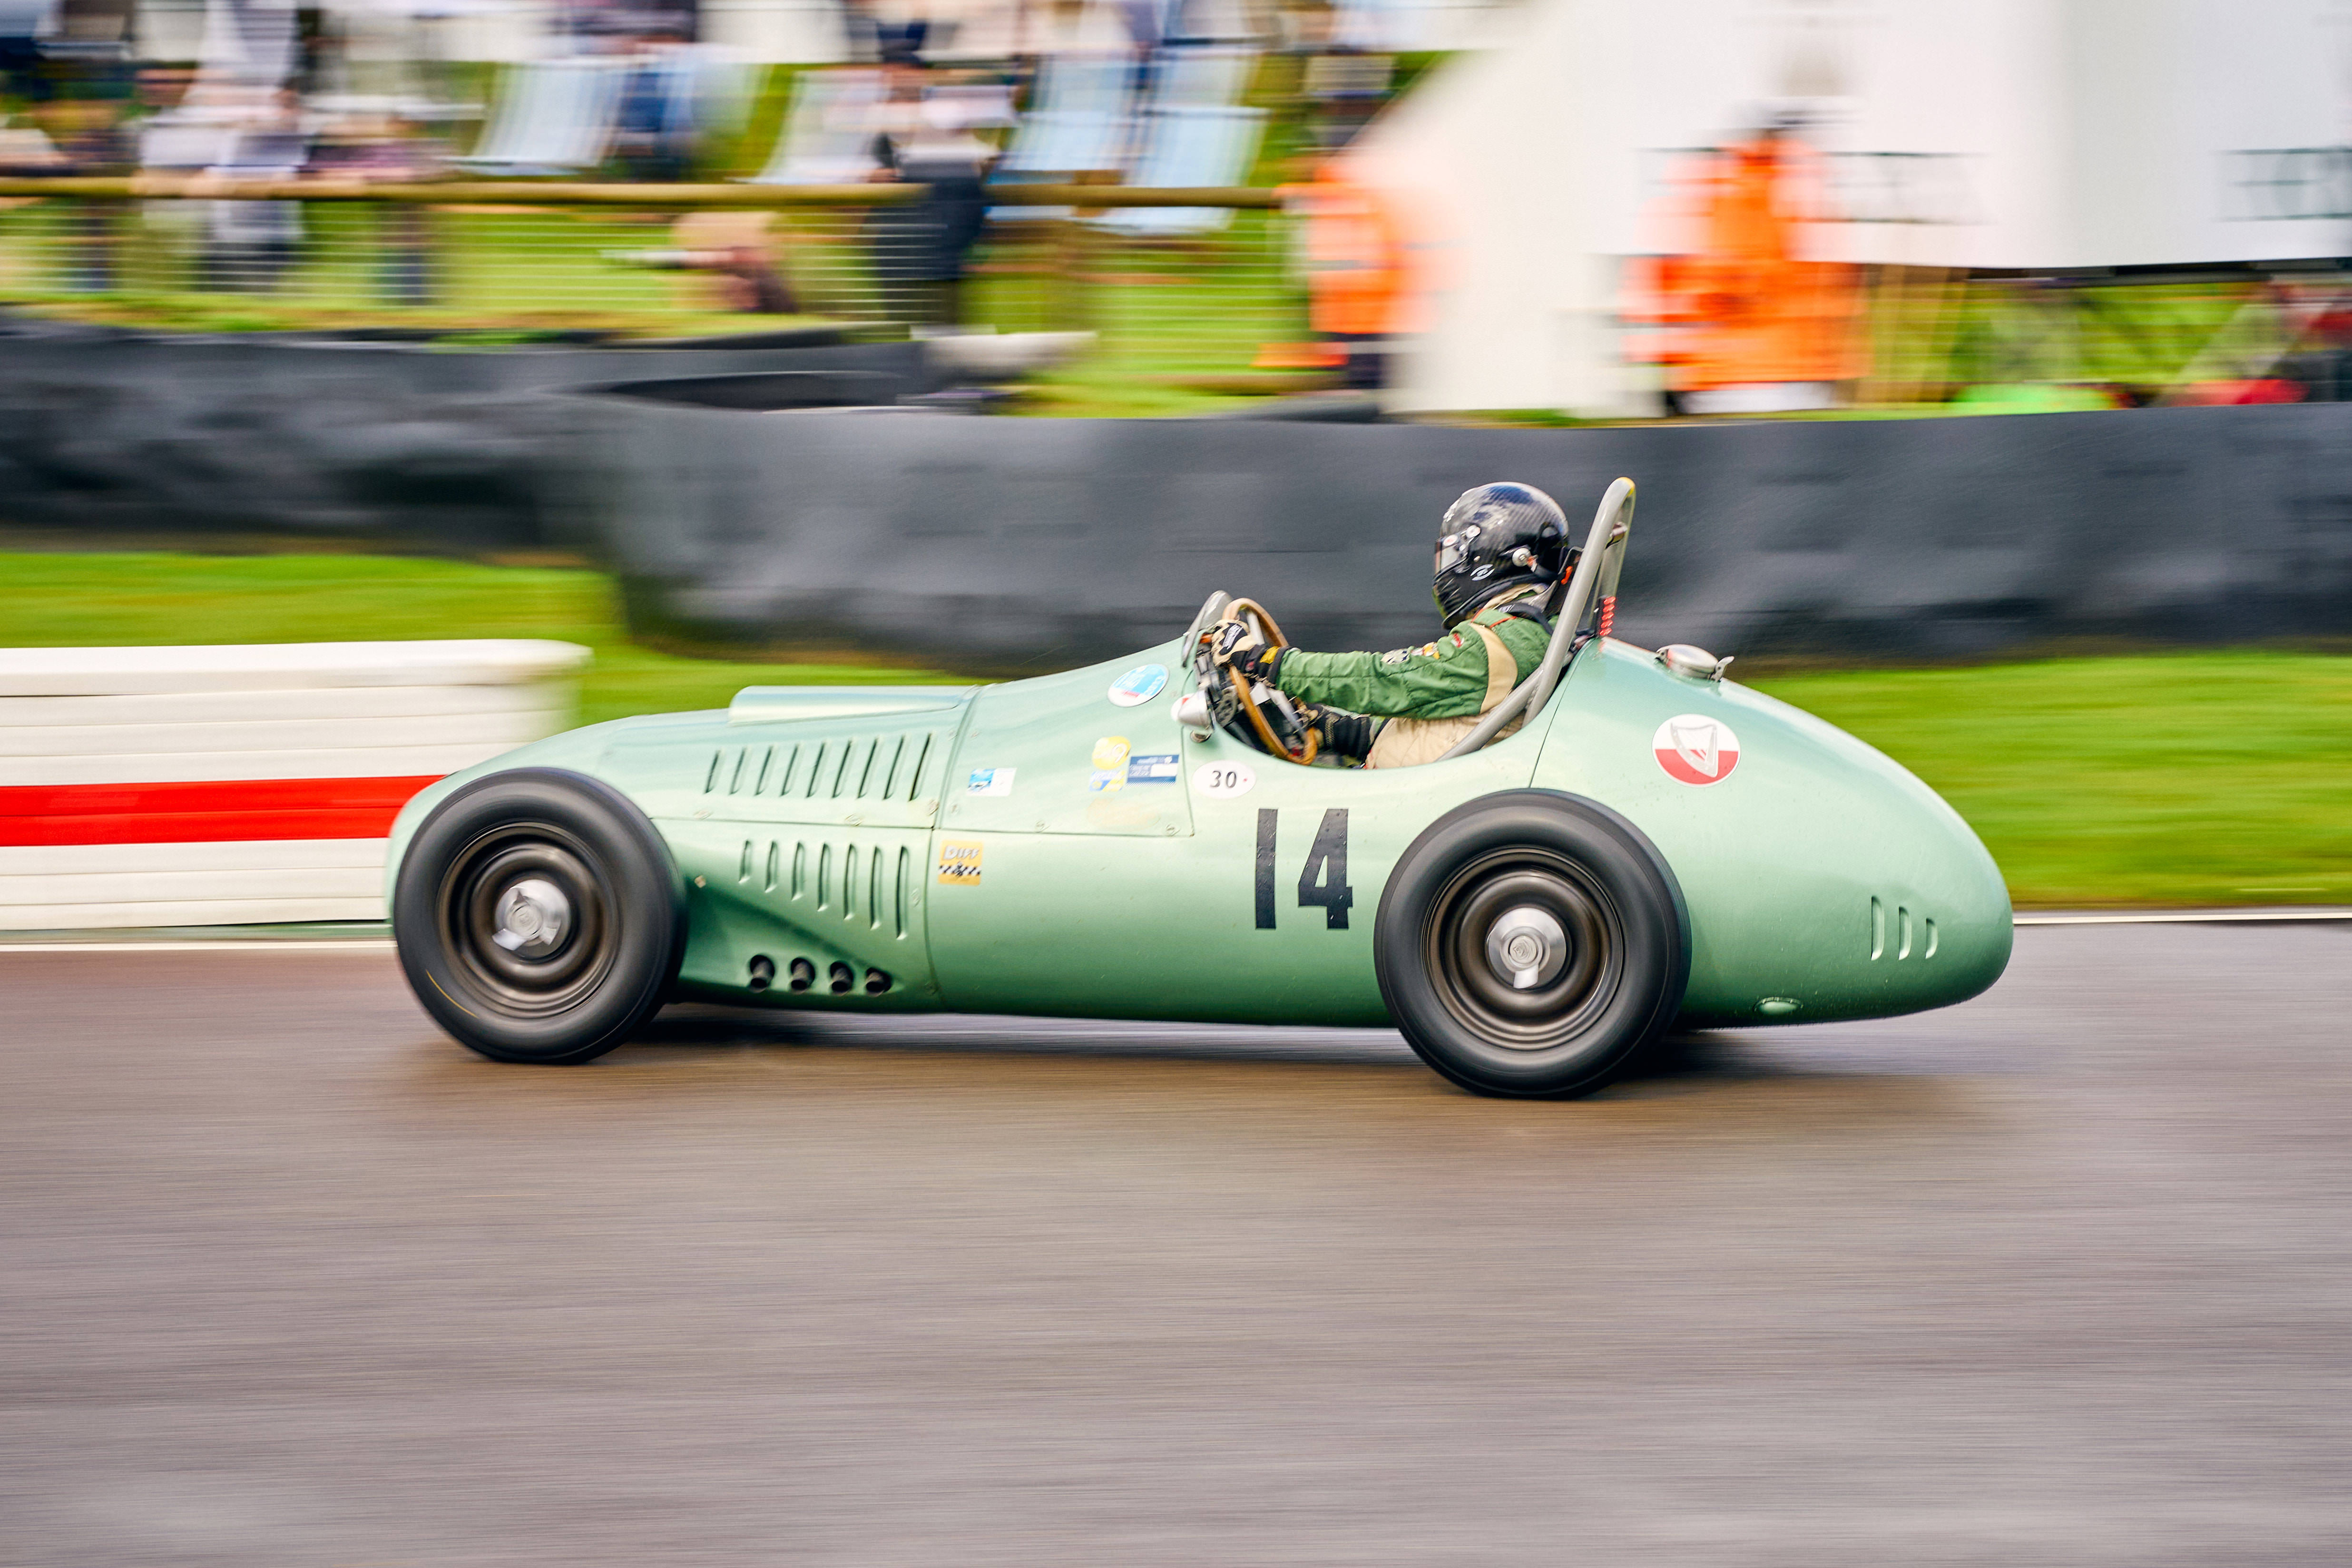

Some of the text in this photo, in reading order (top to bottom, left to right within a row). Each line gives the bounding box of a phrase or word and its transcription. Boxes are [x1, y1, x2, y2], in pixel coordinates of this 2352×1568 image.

[1210, 770, 1237, 788] 30
[942, 845, 980, 860] DIFF
[1255, 808, 1353, 930] 14
